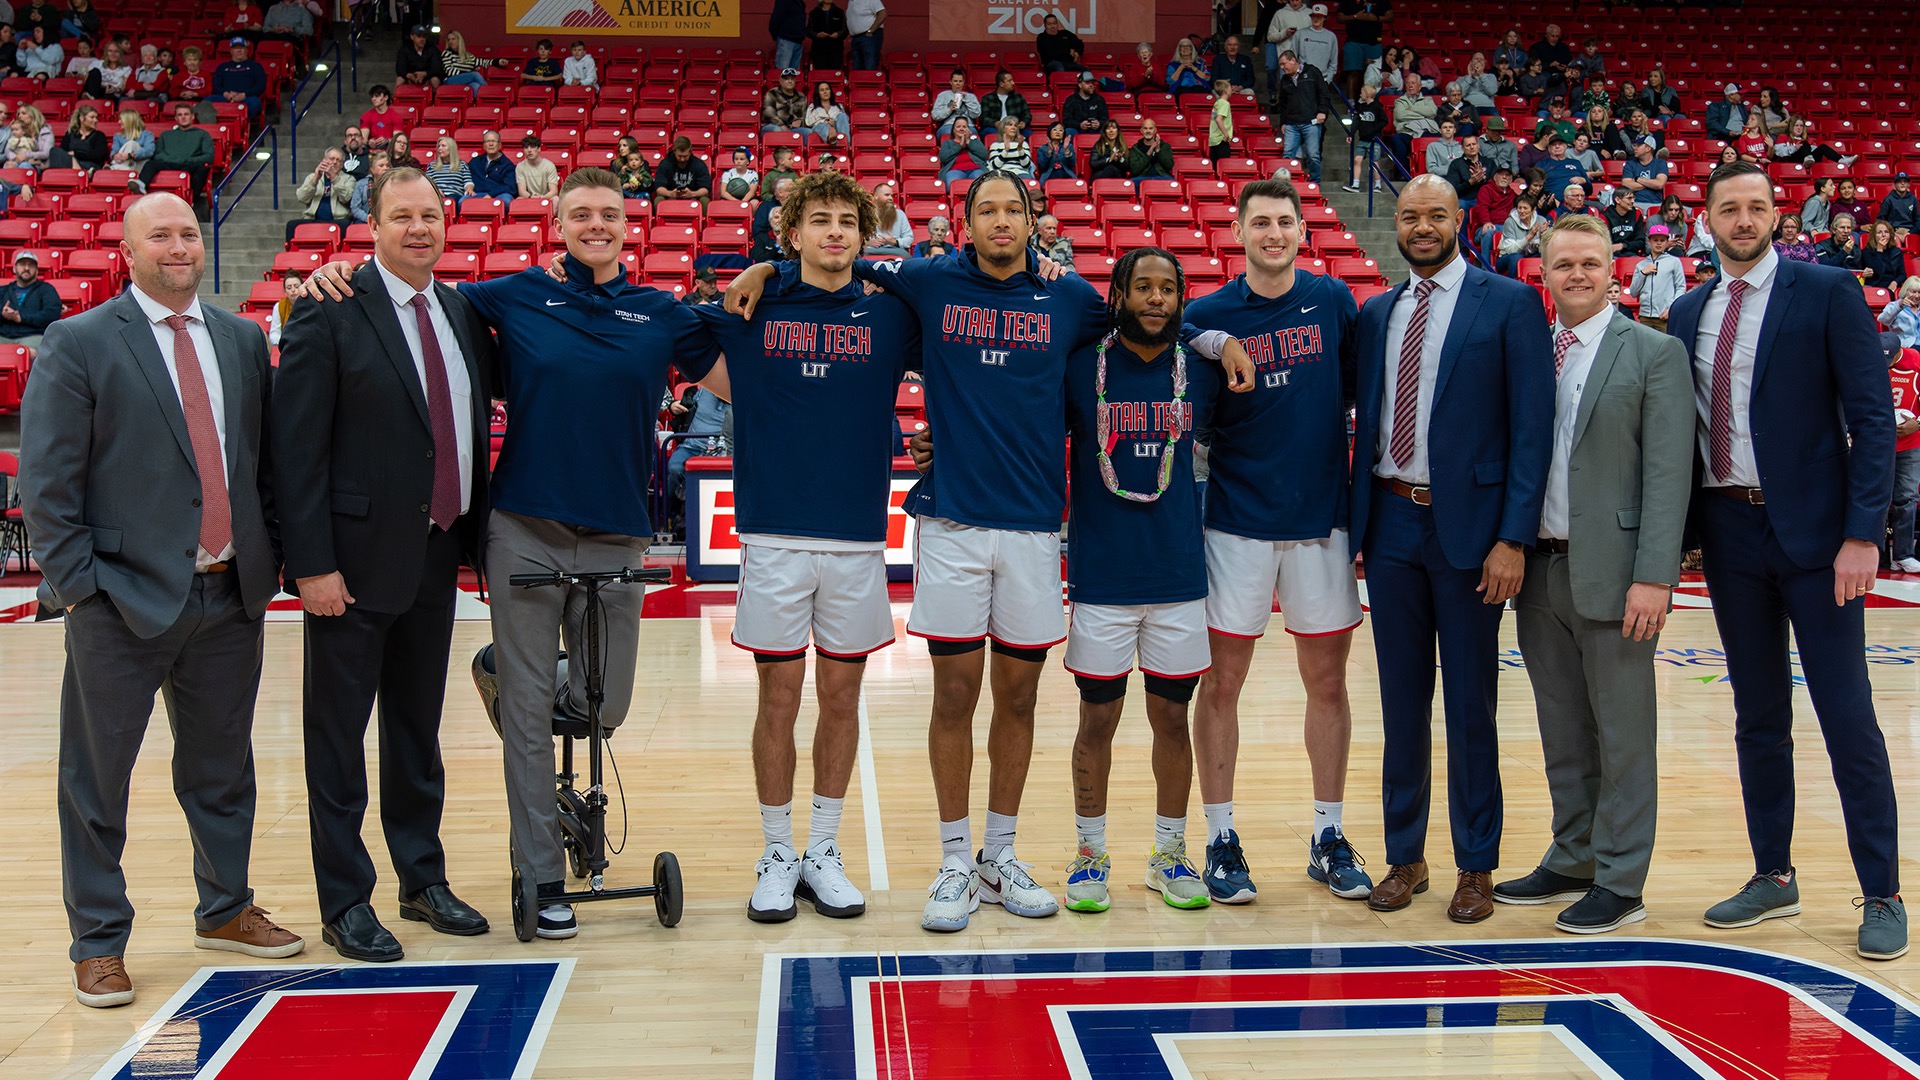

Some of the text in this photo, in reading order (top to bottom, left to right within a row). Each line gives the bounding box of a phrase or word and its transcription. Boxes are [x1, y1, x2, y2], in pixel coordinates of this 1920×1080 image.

[619, 0, 721, 17] AMERICA
[629, 20, 711, 30] CREDIT UNION
[988, 7, 1077, 34] ZION
[615, 310, 650, 321] UTAH TECH
[942, 304, 1051, 343] UTAH TECH
[764, 321, 871, 355] UTAH TECH
[942, 334, 1049, 351] BASKETBALL
[1275, 324, 1322, 358] TECH
[764, 350, 869, 362] BASKETBALL
[980, 349, 1011, 366] UT
[1258, 355, 1322, 372] KETBALL
[801, 362, 831, 378] UT
[1263, 369, 1292, 388] UT
[1108, 402, 1193, 431] TAH TEH
[1133, 442, 1161, 457] UT
